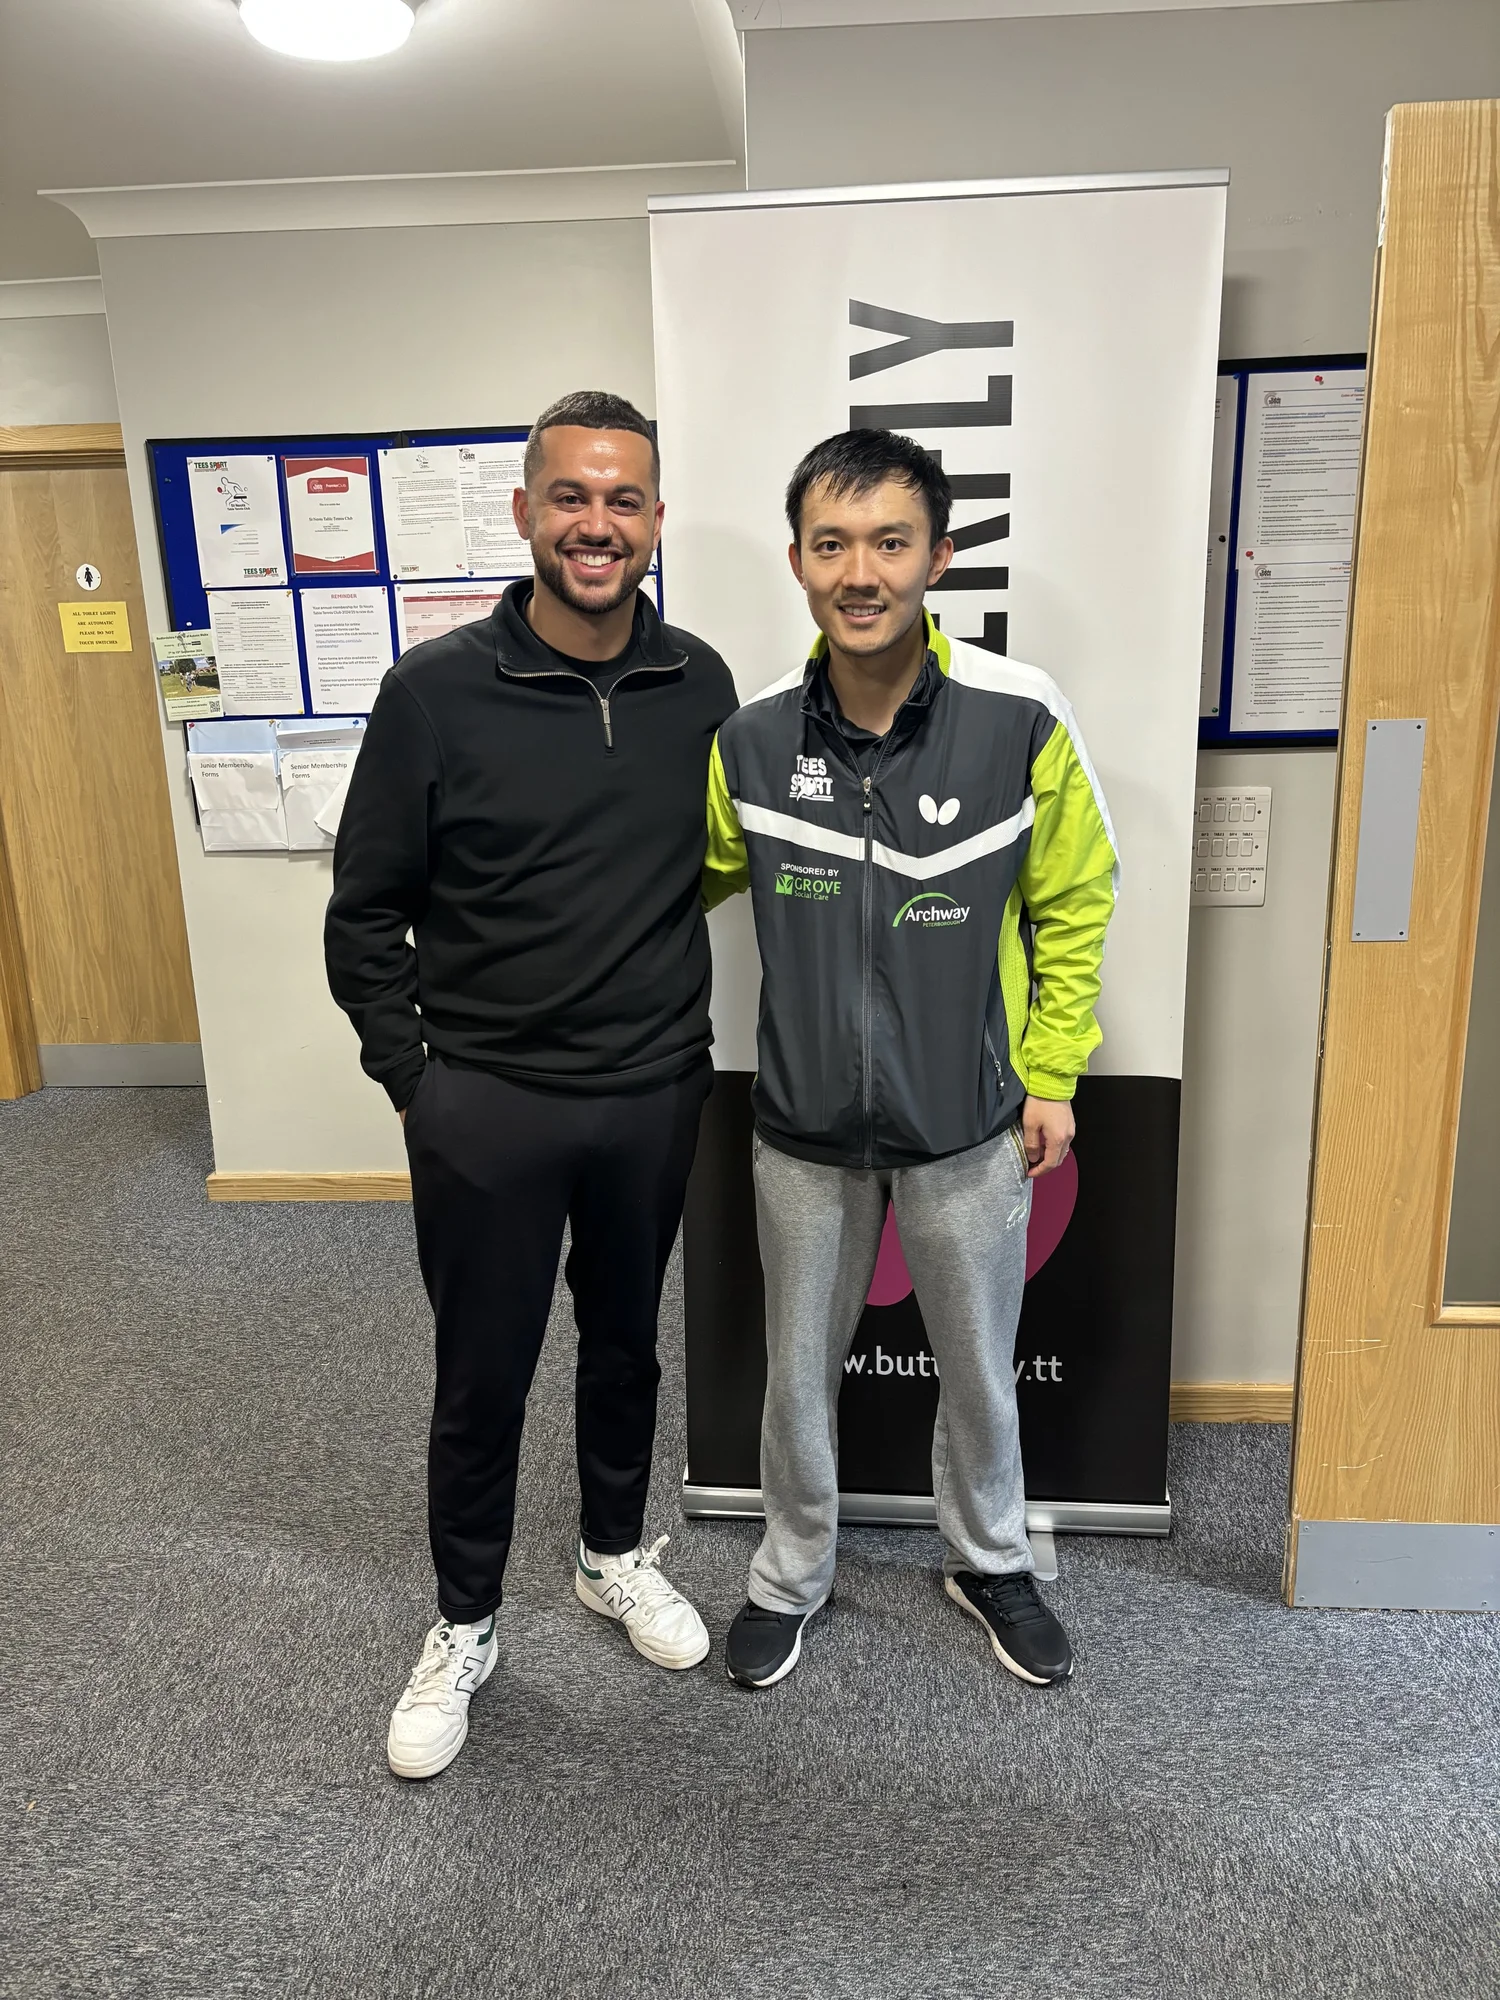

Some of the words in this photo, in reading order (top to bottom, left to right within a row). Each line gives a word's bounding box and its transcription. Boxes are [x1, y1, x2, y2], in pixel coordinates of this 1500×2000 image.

[796, 754, 827, 776] TEES
[790, 774, 833, 796] SPORT
[780, 862, 826, 876] SPONSORED
[794, 891, 811, 899] Social
[795, 876, 841, 895] GROVE
[905, 906, 970, 922] Archway
[601, 1582, 635, 1619] N
[456, 1656, 484, 1694] N
